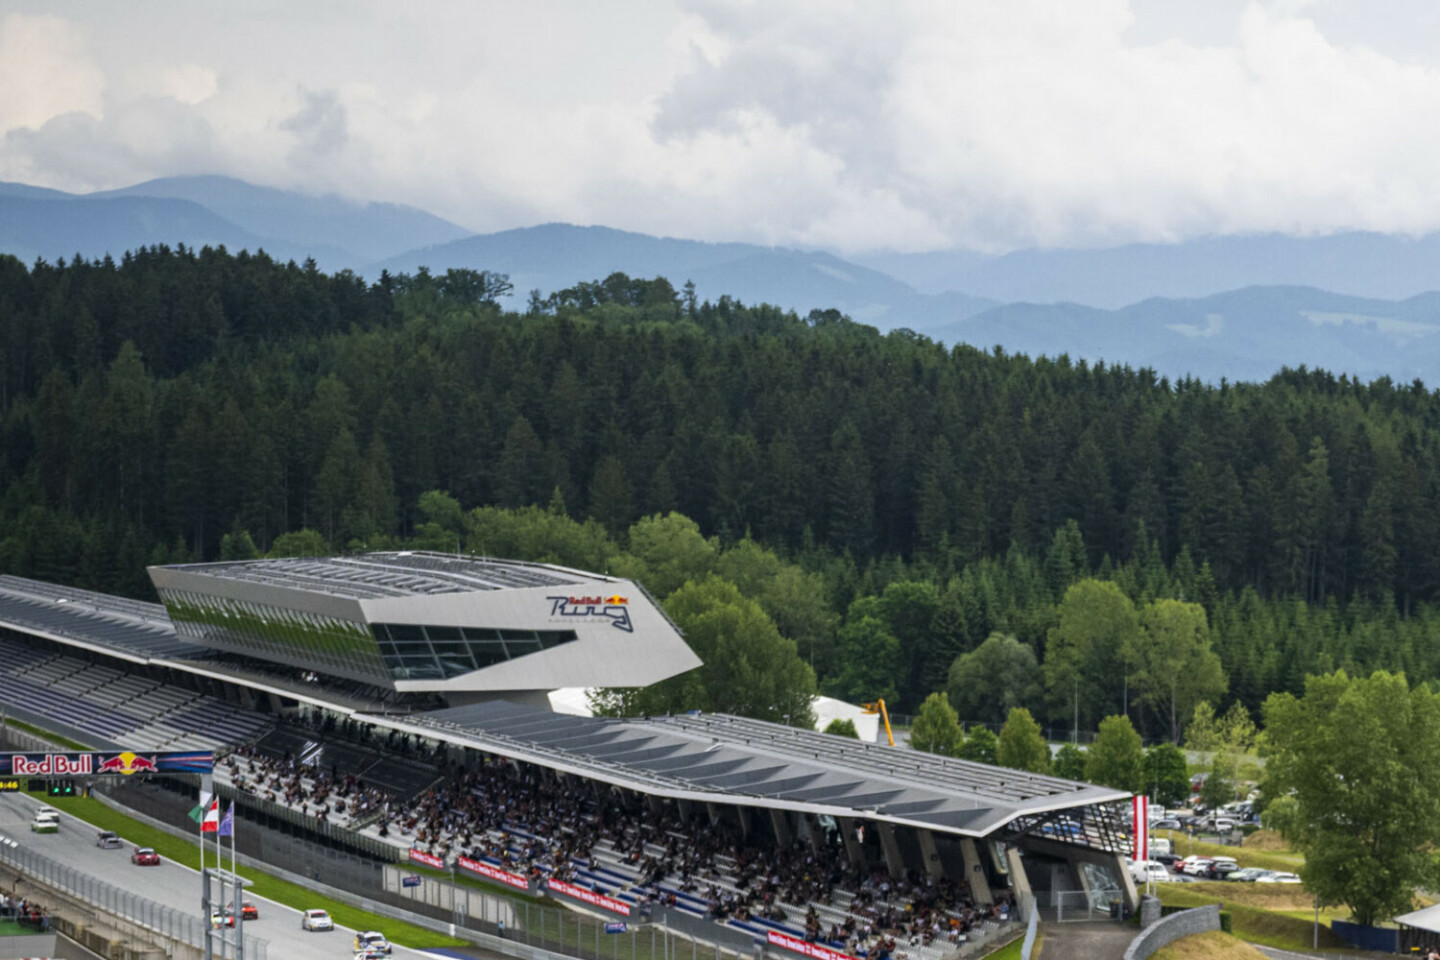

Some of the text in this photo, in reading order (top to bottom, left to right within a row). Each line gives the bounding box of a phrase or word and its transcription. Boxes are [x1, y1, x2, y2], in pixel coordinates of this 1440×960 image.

[569, 596, 602, 605] Red Bull
[12, 754, 92, 775] Red Bull
